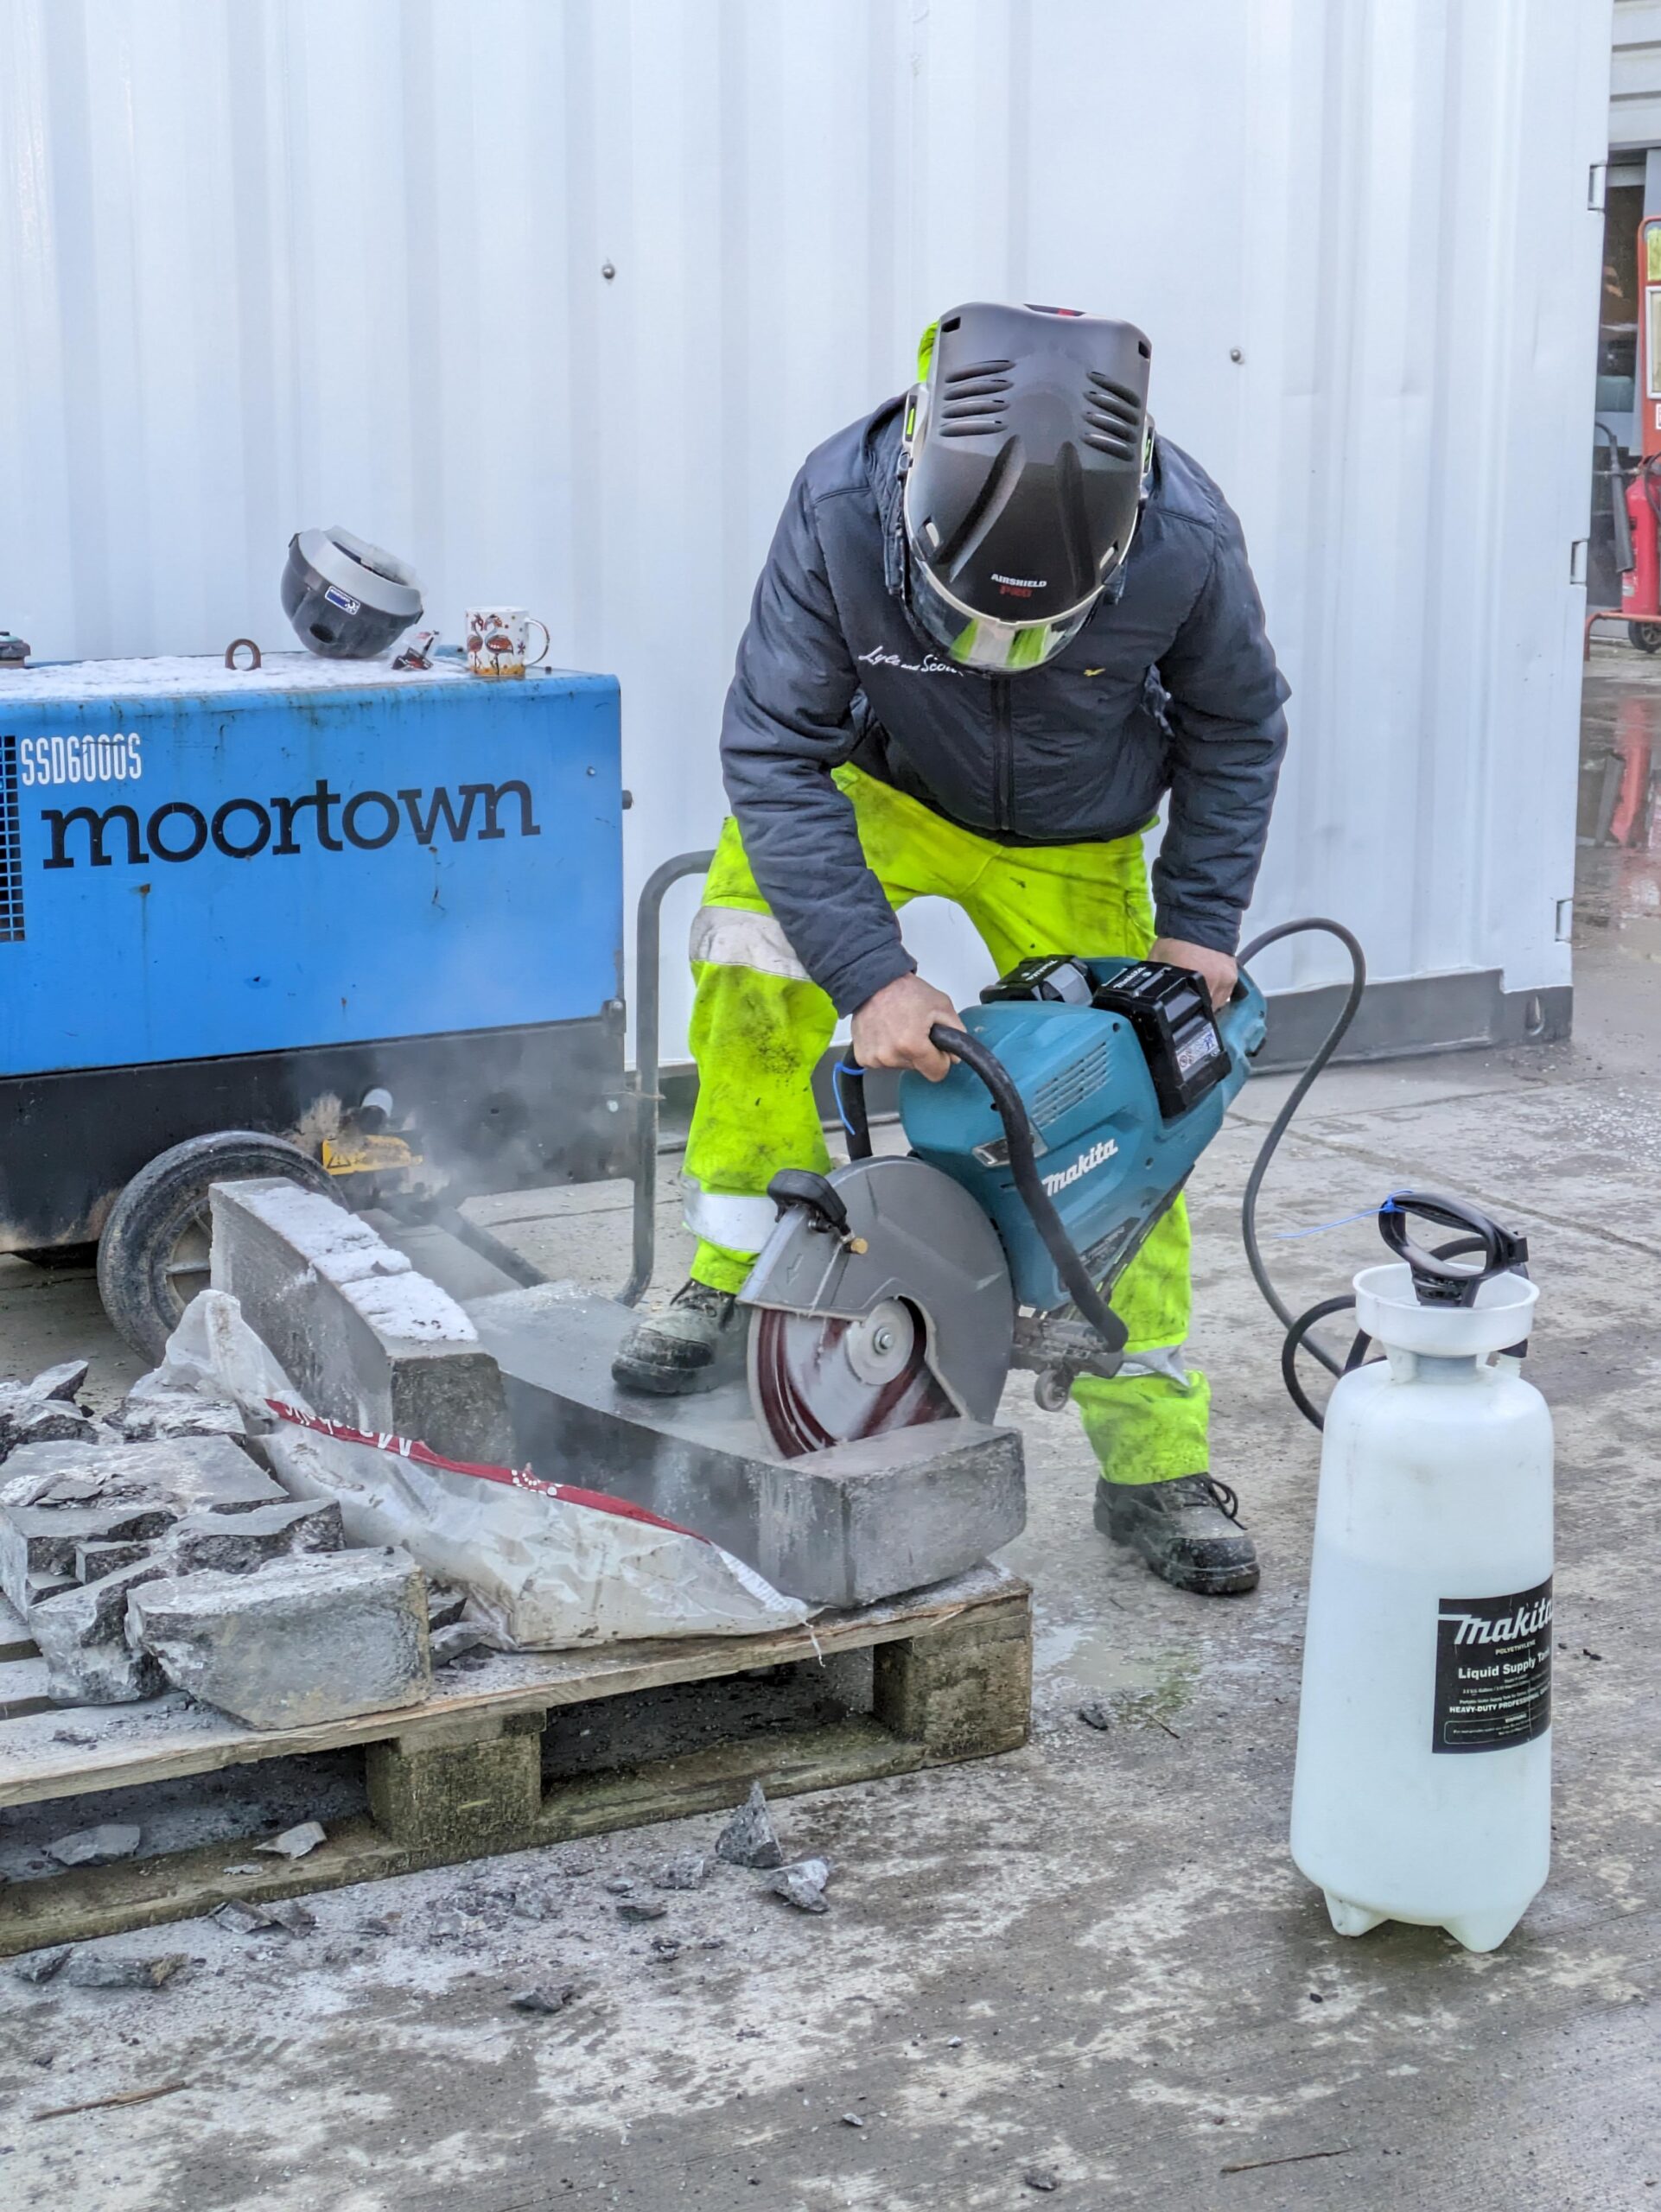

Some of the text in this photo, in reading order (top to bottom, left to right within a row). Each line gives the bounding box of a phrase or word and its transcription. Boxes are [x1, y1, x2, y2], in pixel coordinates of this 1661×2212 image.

[990, 573, 1047, 588] AIRSHIELD
[858, 645, 901, 665] Lyle
[21, 732, 142, 786] SSD6000S
[41, 779, 541, 869] moortown
[1458, 1665, 1499, 1680] Liquid
[1503, 1656, 1536, 1675] Supply
[1449, 1704, 1497, 1713] HEAVY-DUTY
